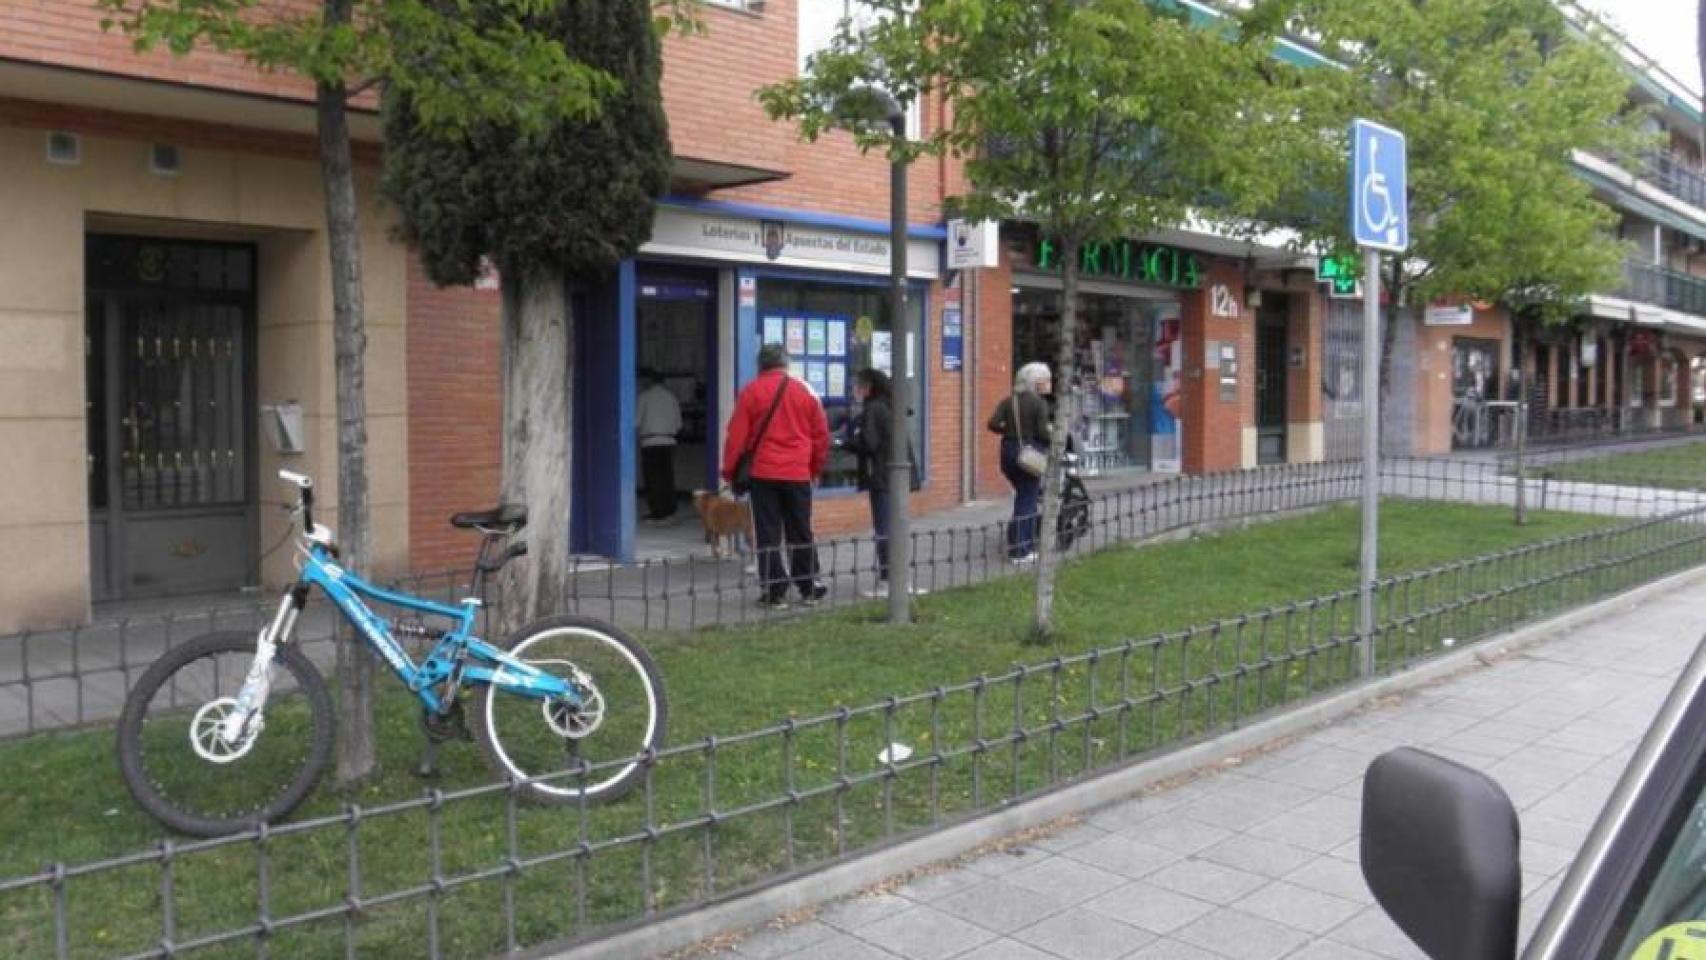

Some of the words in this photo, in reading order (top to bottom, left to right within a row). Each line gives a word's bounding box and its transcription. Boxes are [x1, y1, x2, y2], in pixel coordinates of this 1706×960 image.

[786, 232, 834, 249] Apuestas
[837, 236, 850, 251] del
[853, 238, 888, 256] Estado
[1211, 284, 1239, 318] 12h
